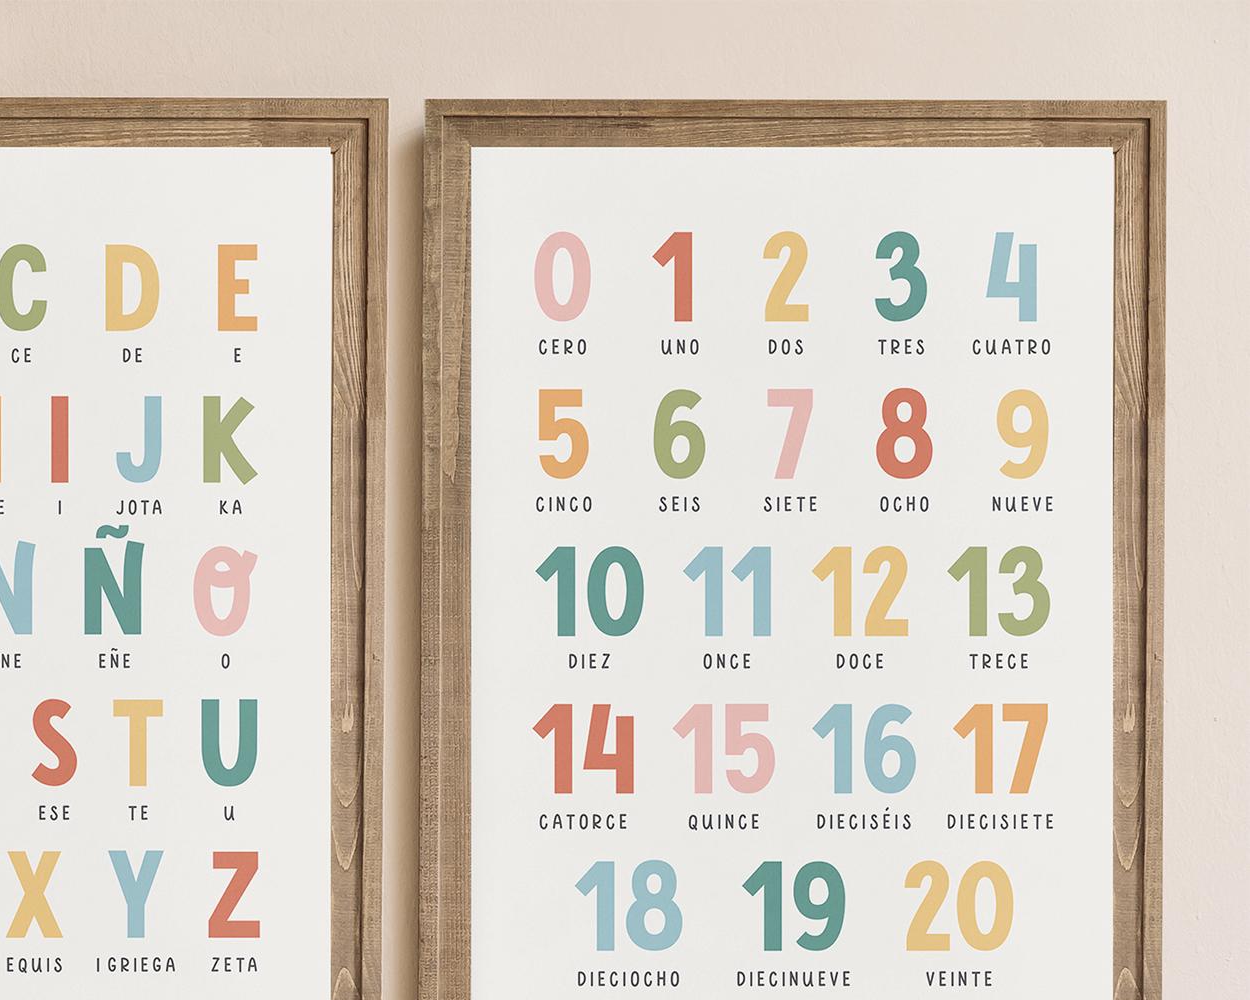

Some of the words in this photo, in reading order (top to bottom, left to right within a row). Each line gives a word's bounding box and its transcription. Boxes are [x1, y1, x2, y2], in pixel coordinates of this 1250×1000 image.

[104, 243, 161, 333] D
[217, 243, 259, 333] E
[534, 231, 591, 322] 0
[651, 231, 694, 323] 1
[762, 230, 810, 323] 2
[874, 230, 928, 323] 3
[985, 231, 1038, 323] 4
[10, 347, 32, 364] CE
[122, 347, 143, 364] DE
[233, 347, 242, 364] E
[538, 338, 587, 356] CERO
[660, 338, 700, 356] UNO
[768, 338, 804, 356] DOS
[877, 338, 925, 356] TRES
[972, 338, 1051, 356] CUATRO
[50, 395, 70, 484] I
[115, 395, 163, 484] J
[202, 395, 259, 486] K
[537, 388, 590, 480] 5
[652, 388, 707, 480] 6
[766, 388, 814, 480] 7
[875, 387, 934, 480] 8
[996, 388, 1050, 480] 9
[115, 498, 163, 516] JOTA
[219, 499, 243, 516] KA
[535, 495, 593, 513] CINCO
[658, 495, 701, 513] SEIS
[763, 495, 818, 513] SIETE
[879, 495, 930, 513] OCHO
[991, 495, 1054, 513] NUEVE
[83, 524, 146, 636] Ñ
[193, 545, 258, 637] O
[534, 545, 645, 638] 10
[682, 545, 772, 637] 11
[811, 545, 910, 638] 12
[946, 545, 1051, 638] 13
[98, 647, 131, 669] EÑE
[220, 652, 231, 670] O
[568, 652, 611, 670] DIEZ
[702, 652, 751, 670] ONCE
[836, 652, 884, 670] DOCE
[968, 652, 1029, 670] TRECE
[30, 698, 78, 788] S
[112, 698, 164, 788] T
[200, 698, 259, 788] U
[531, 703, 635, 795] 14
[672, 703, 776, 794] 15
[811, 703, 917, 795] 16
[952, 702, 1049, 795] 17
[38, 804, 71, 822] ESE
[127, 804, 149, 822] TE
[223, 805, 236, 822] U
[538, 813, 628, 831] CATORCE
[688, 813, 760, 832] QUINCE
[816, 807, 912, 831] DIECISÉIS
[947, 813, 1054, 831] DIECISIETE
[5, 850, 64, 939] X
[107, 849, 165, 939] Y
[207, 850, 261, 939] Z
[574, 859, 684, 952] 18
[741, 860, 847, 952] 19
[903, 859, 1015, 952] 20
[6, 956, 63, 974] EQUIS
[210, 956, 258, 974] ZETA
[577, 970, 680, 988] DIECIOCHO
[736, 970, 851, 988] DIECINUEVE
[925, 970, 993, 988] VEINTE
